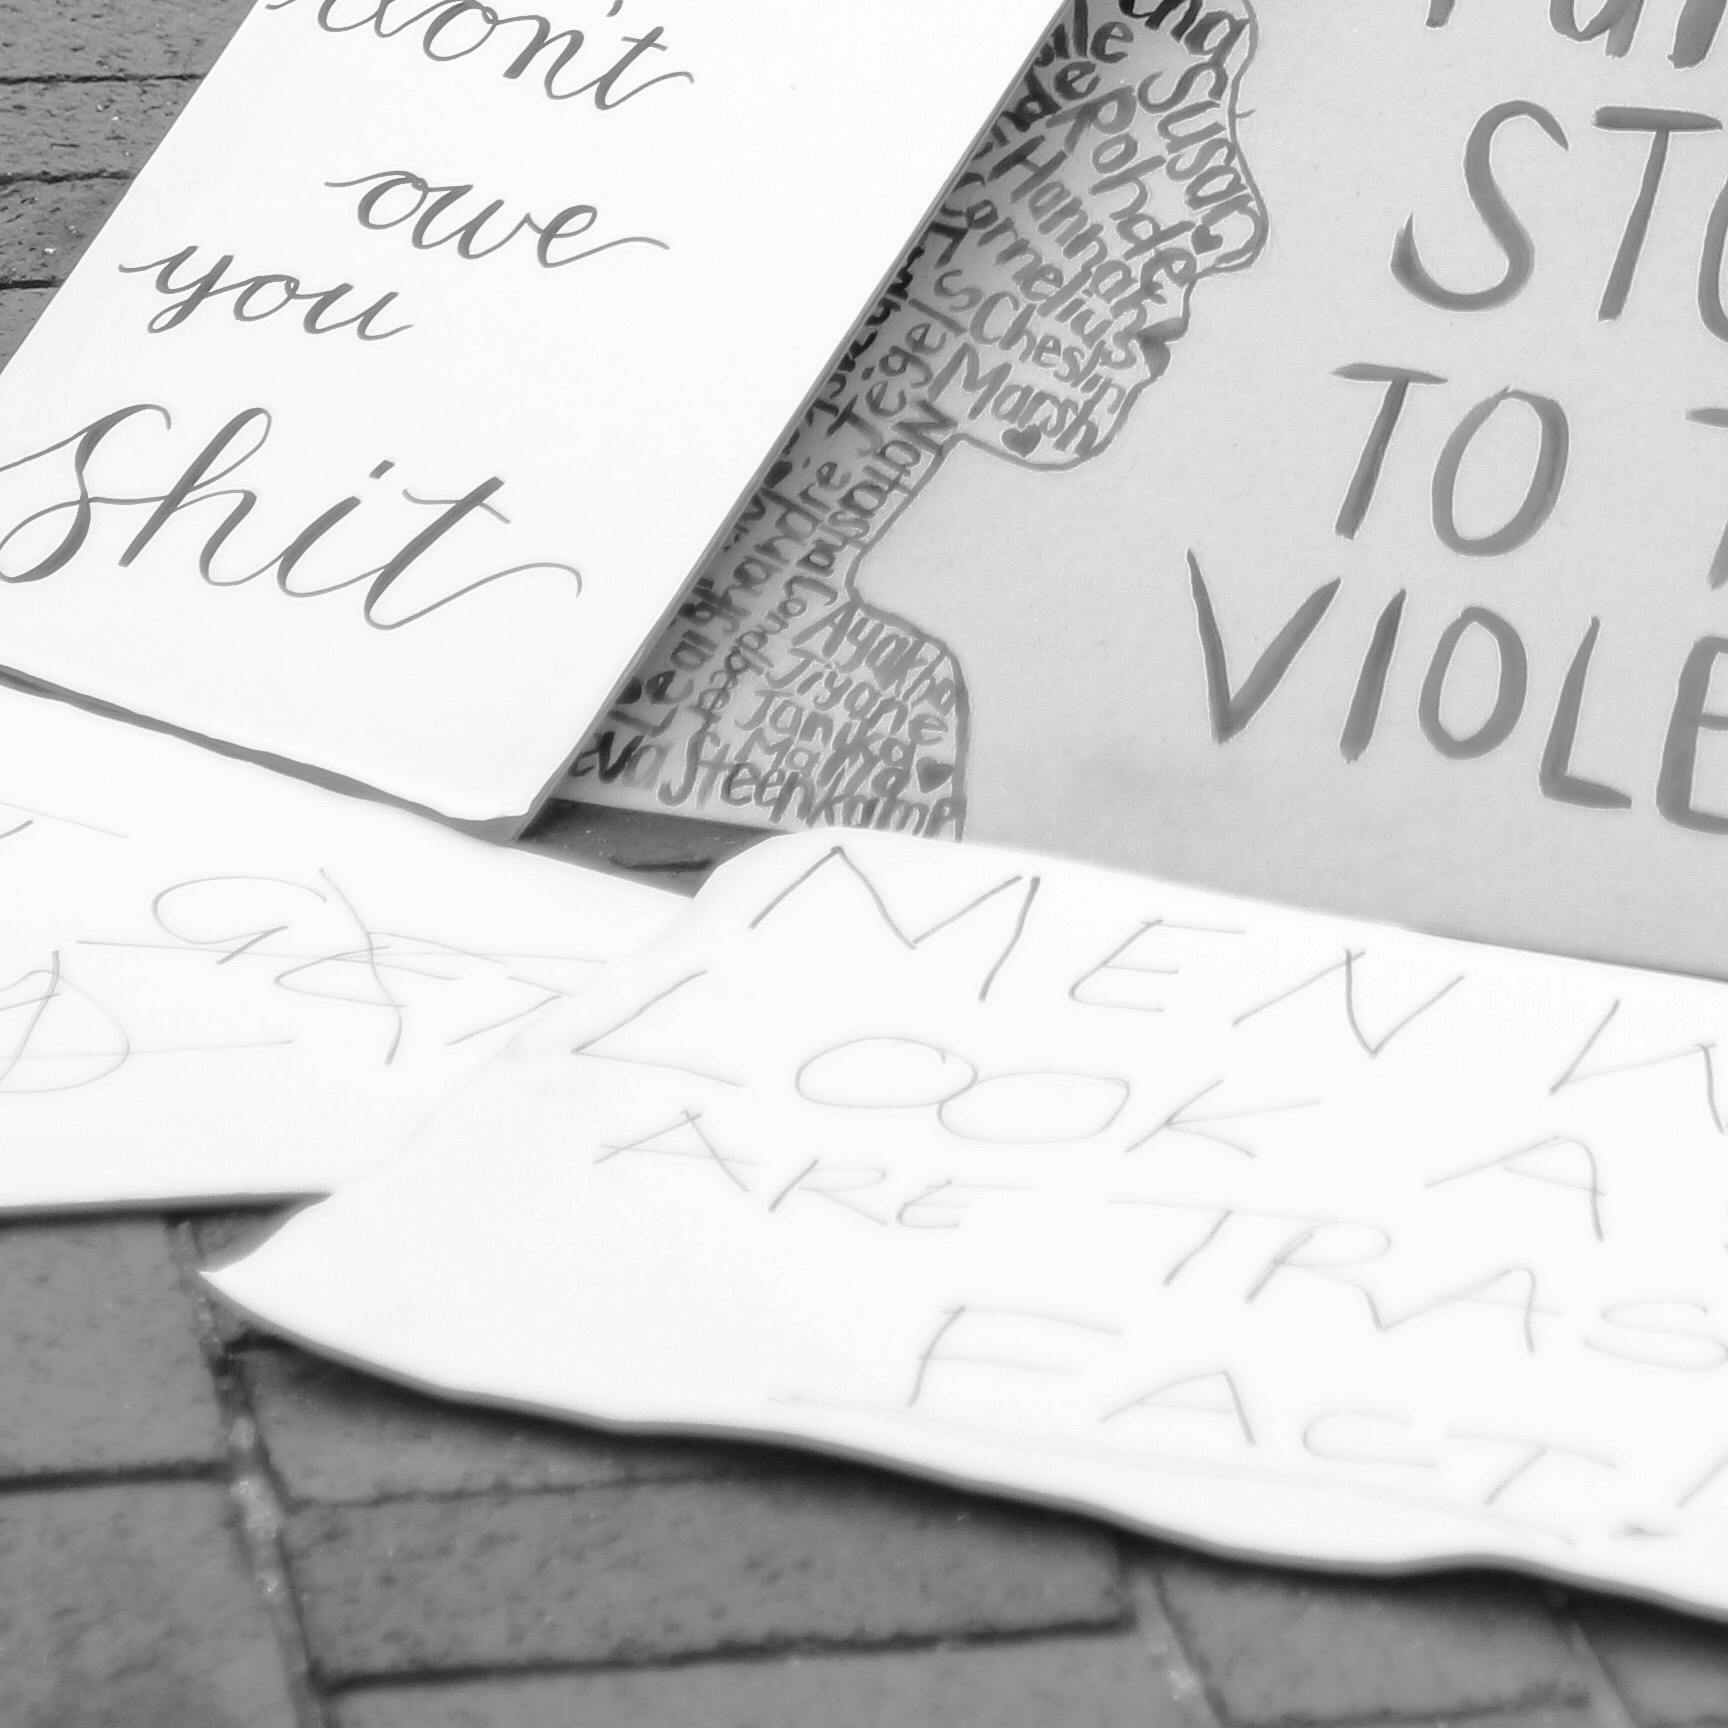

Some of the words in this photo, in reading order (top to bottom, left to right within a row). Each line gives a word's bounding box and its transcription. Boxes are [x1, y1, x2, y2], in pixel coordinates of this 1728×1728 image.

[323, 168, 671, 268] owe
[1136, 61, 1264, 266] Susan
[117, 243, 415, 341] you
[927, 342, 1100, 458] Marsh
[1331, 361, 1572, 558] TO
[568, 730, 672, 791] eva
[748, 845, 1464, 1058] MEN
[572, 968, 1324, 1159] LOOK
[594, 1111, 1040, 1229] ARE
